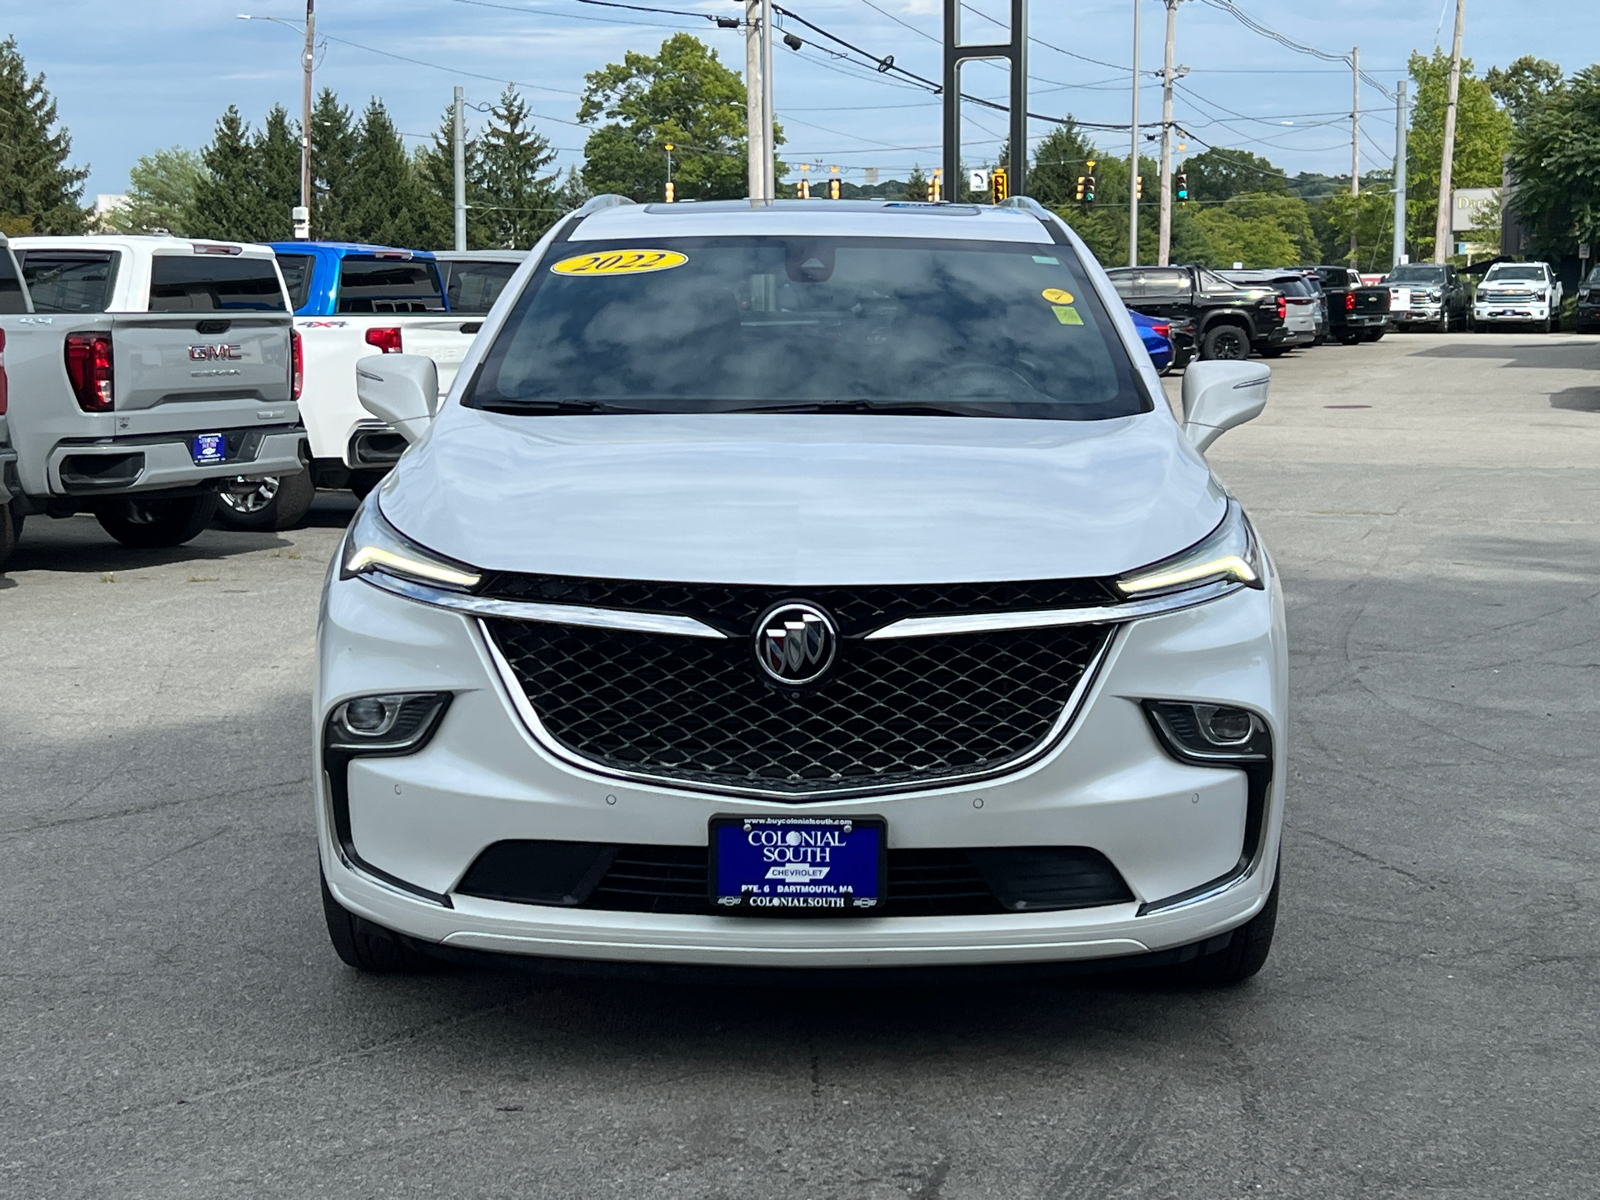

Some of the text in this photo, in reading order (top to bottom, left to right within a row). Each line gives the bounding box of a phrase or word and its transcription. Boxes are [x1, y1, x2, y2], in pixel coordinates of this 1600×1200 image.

[570, 253, 667, 272] 2022
[188, 344, 242, 361] GMC
[743, 818, 853, 826] www.buycolonialsouth.com
[748, 830, 847, 846] COLONIAL
[763, 847, 831, 862] SOUTH
[771, 869, 823, 877] CHEVROLET
[763, 885, 770, 893] 6
[777, 885, 838, 894] DARTMOUTH,
[839, 885, 854, 893] MA
[749, 896, 845, 907] COLONIAL SOUTH
